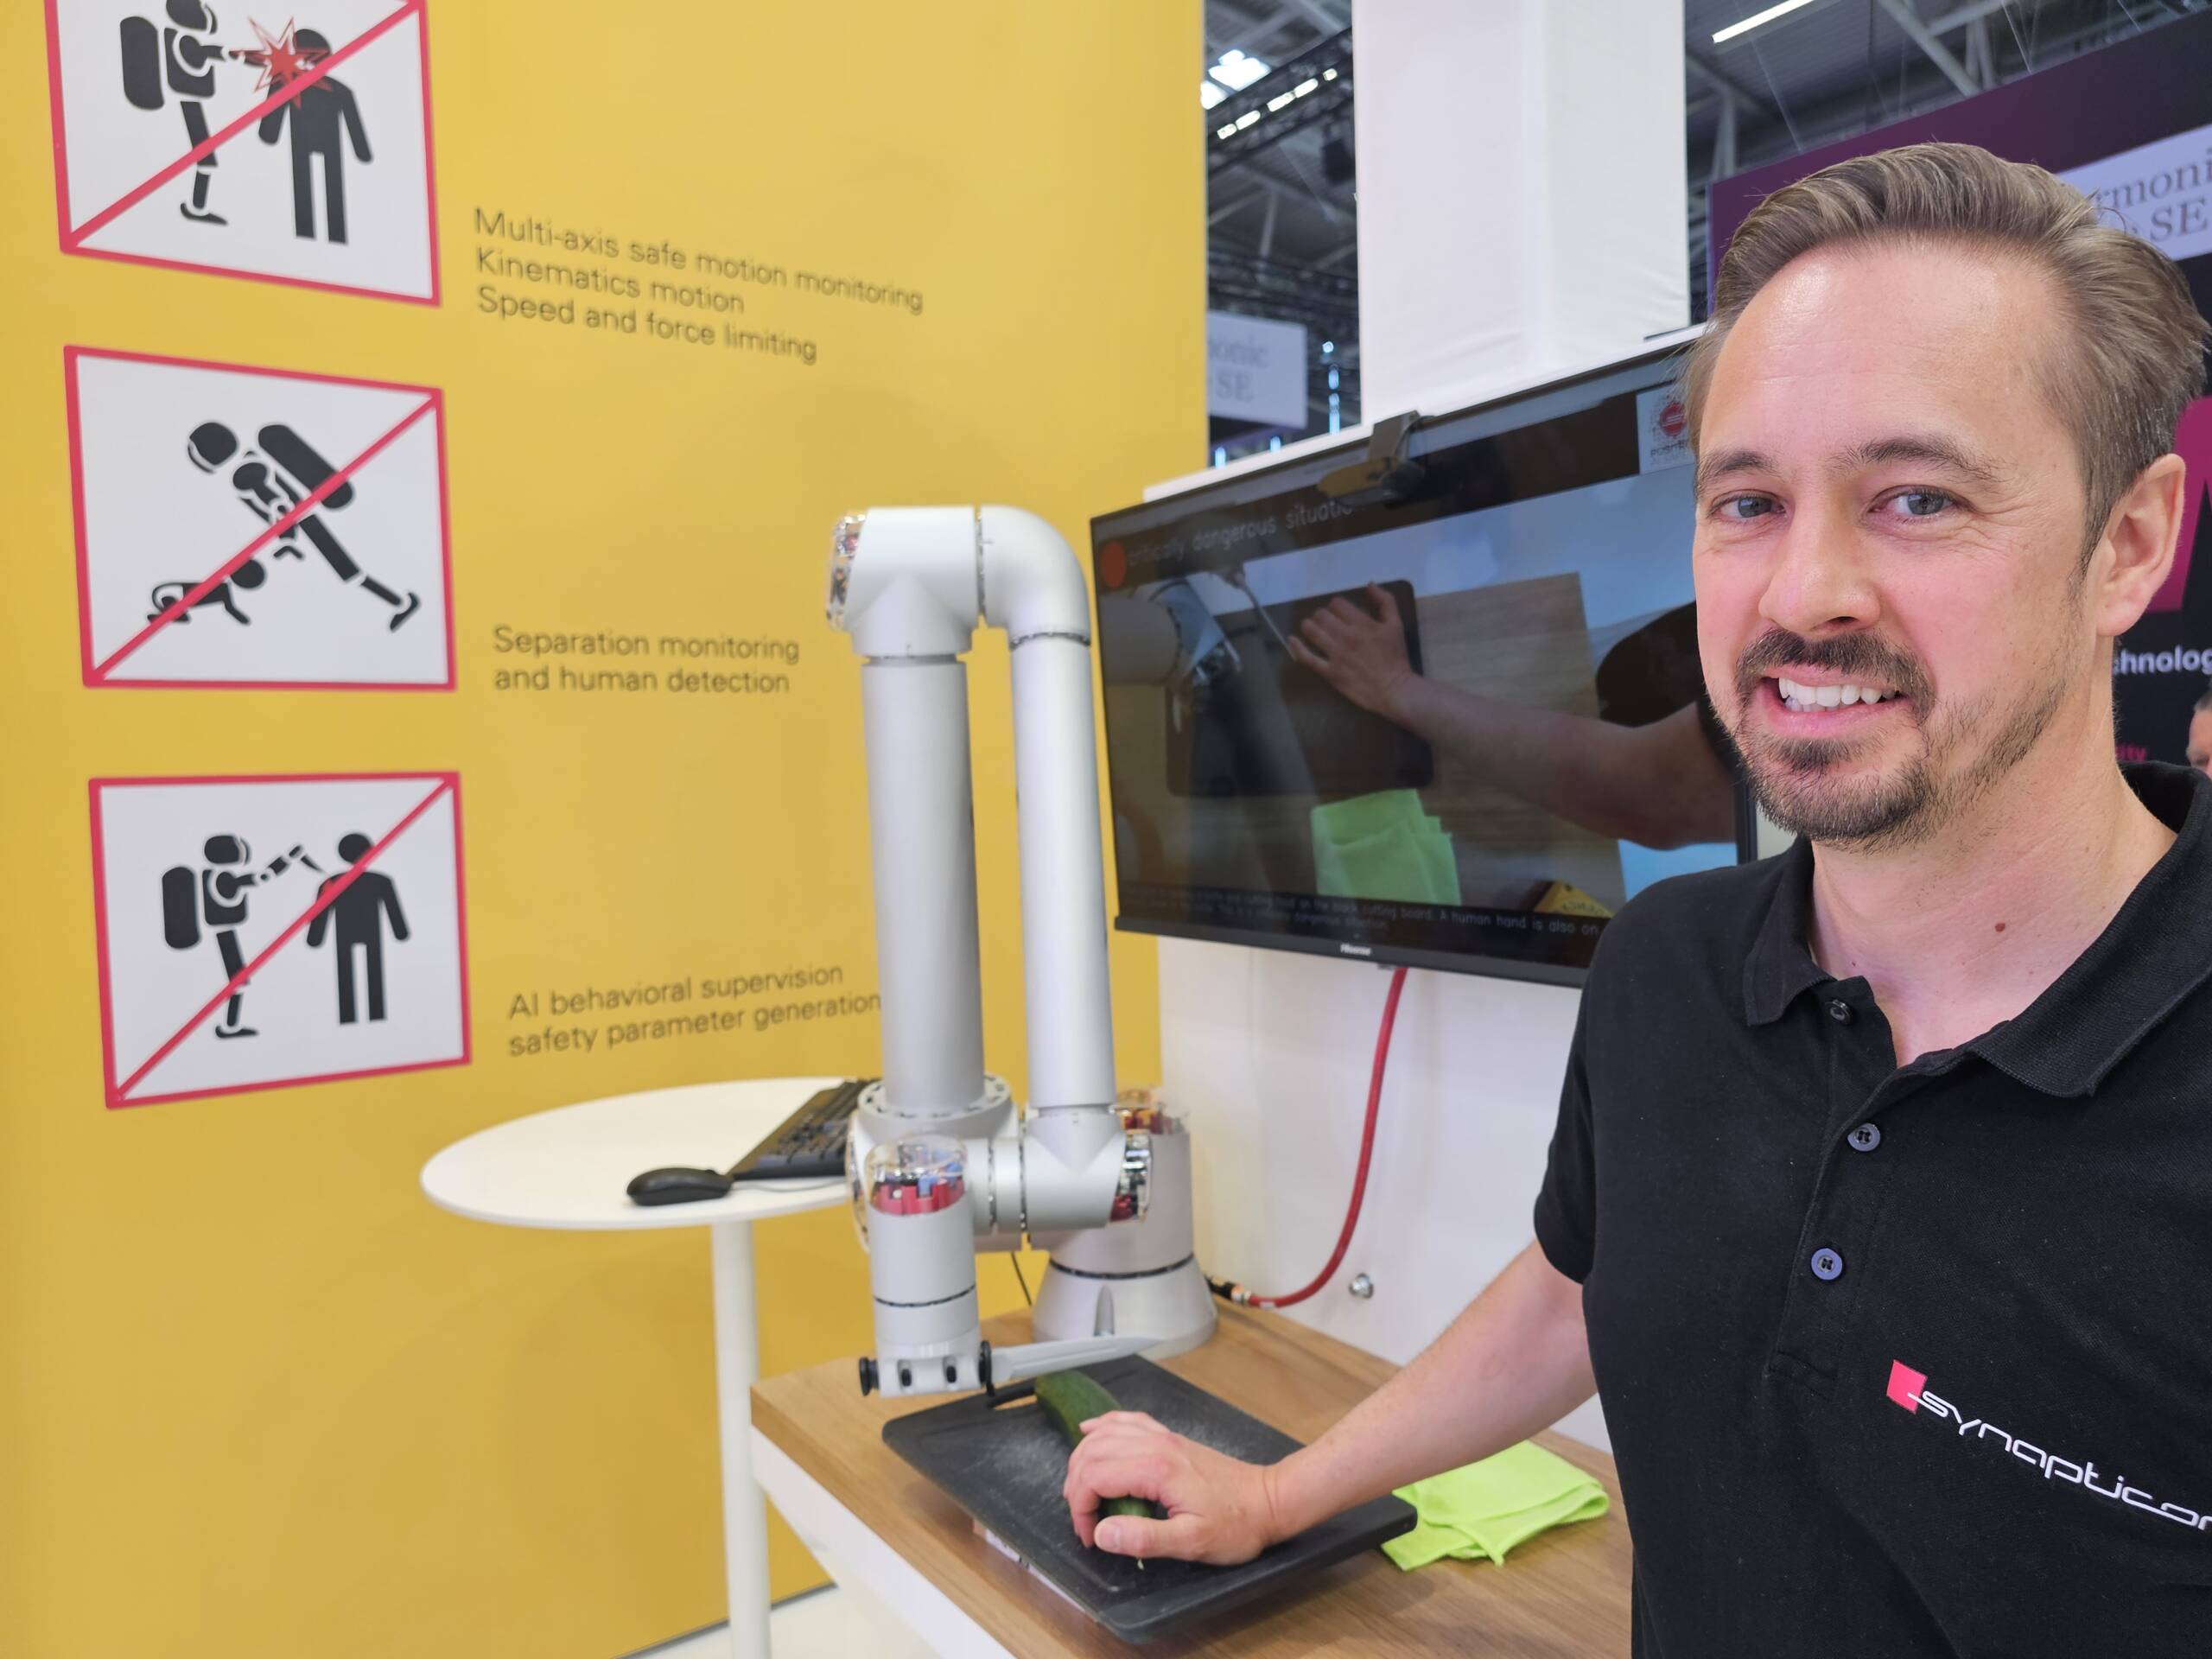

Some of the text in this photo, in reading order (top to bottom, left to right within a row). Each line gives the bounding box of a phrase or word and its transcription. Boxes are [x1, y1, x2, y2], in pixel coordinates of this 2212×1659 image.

[2150, 197, 2209, 243] SE
[474, 207, 924, 316] Multi-axis safe motion monitoring
[475, 247, 745, 315] Kinematics motion
[477, 285, 817, 366] Speed and force limiting
[1192, 515, 1276, 552] dangerous
[1285, 500, 1360, 529] situatio
[493, 624, 800, 665] Separation monitoring
[493, 665, 791, 694] and human detection
[1452, 911, 1491, 926] human
[1496, 914, 1527, 930] hand
[1532, 917, 1543, 931] is
[1548, 918, 1575, 934] also
[508, 964, 844, 1020] AI behavioral supervision
[508, 991, 882, 1058] safety parameter generation
